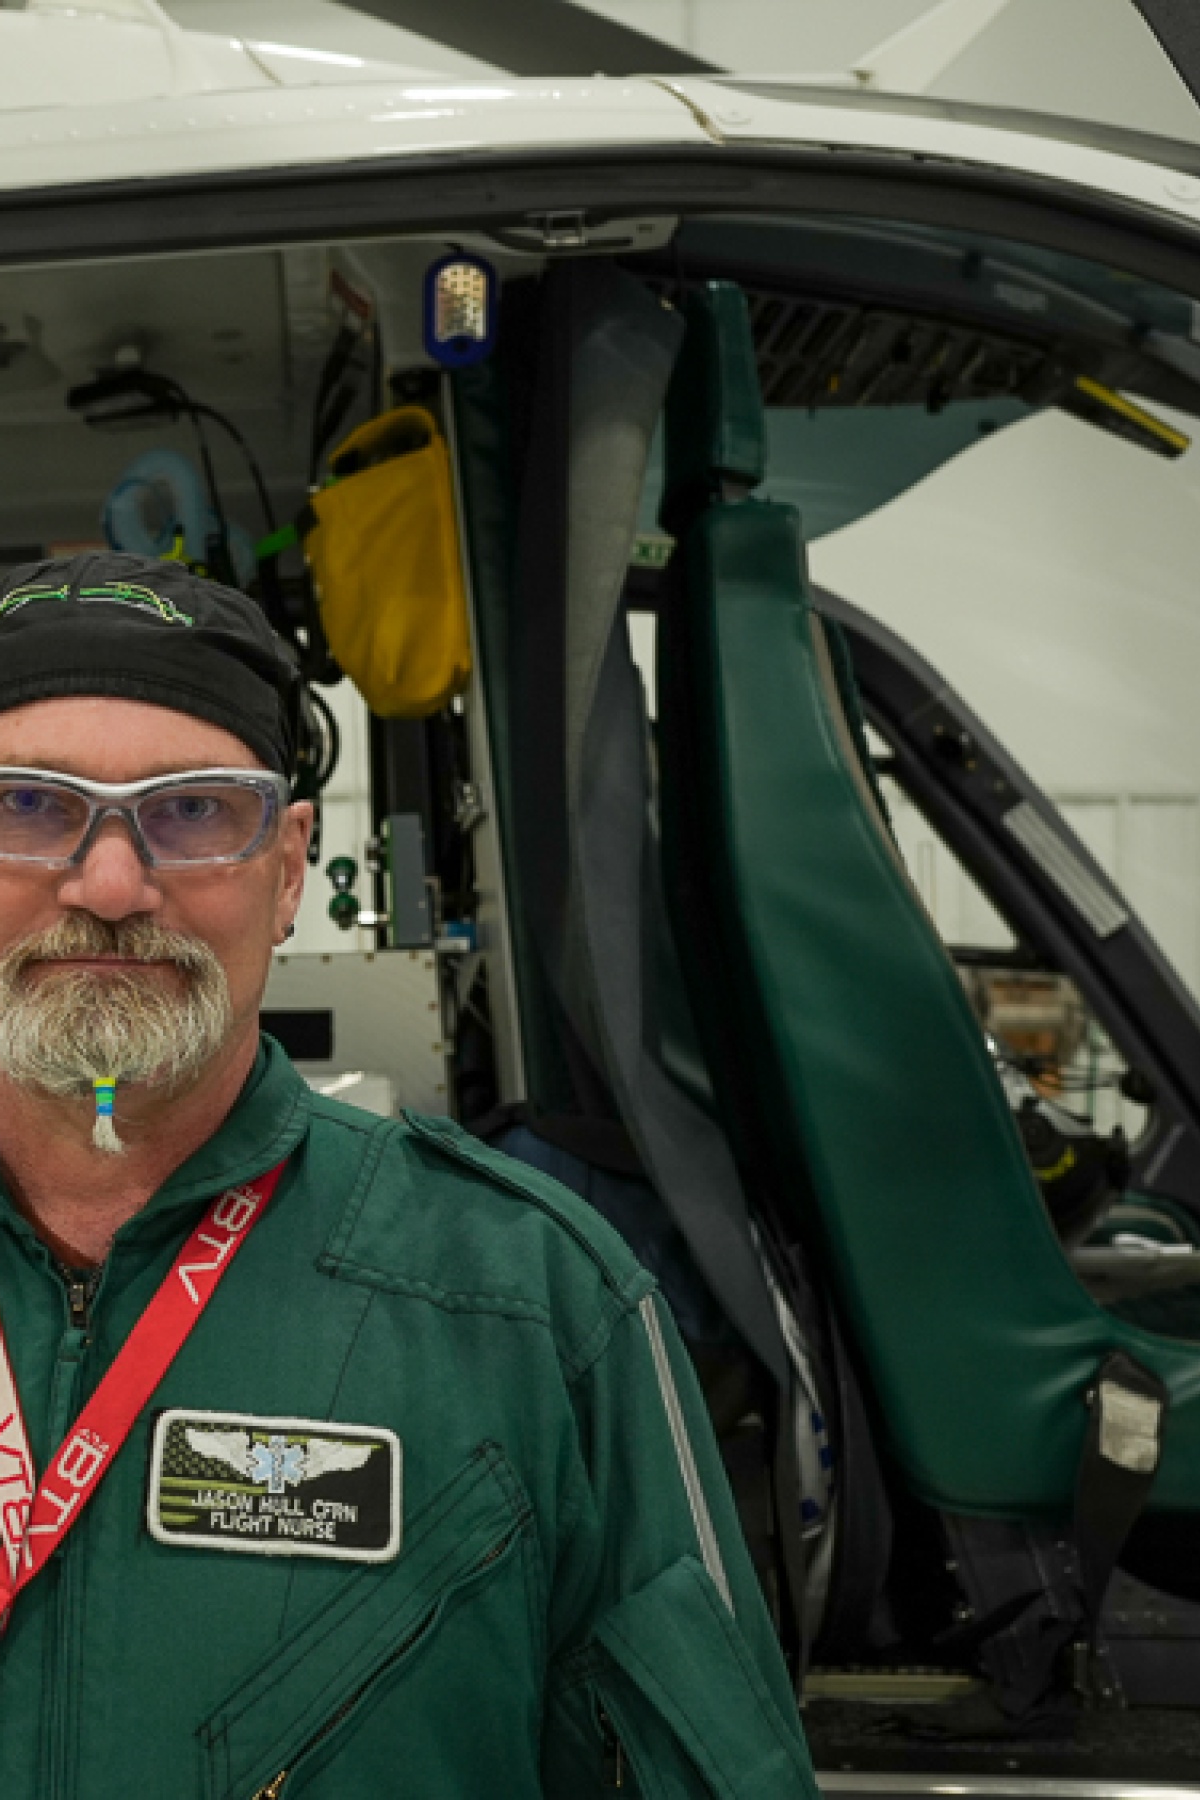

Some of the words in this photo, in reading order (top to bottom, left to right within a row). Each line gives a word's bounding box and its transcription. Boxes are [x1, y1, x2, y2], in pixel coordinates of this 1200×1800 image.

[178, 1188, 257, 1305] BTV
[191, 1489, 253, 1512] JASON
[210, 1511, 273, 1534] FLIGHT
[277, 1517, 337, 1541] NURSE
